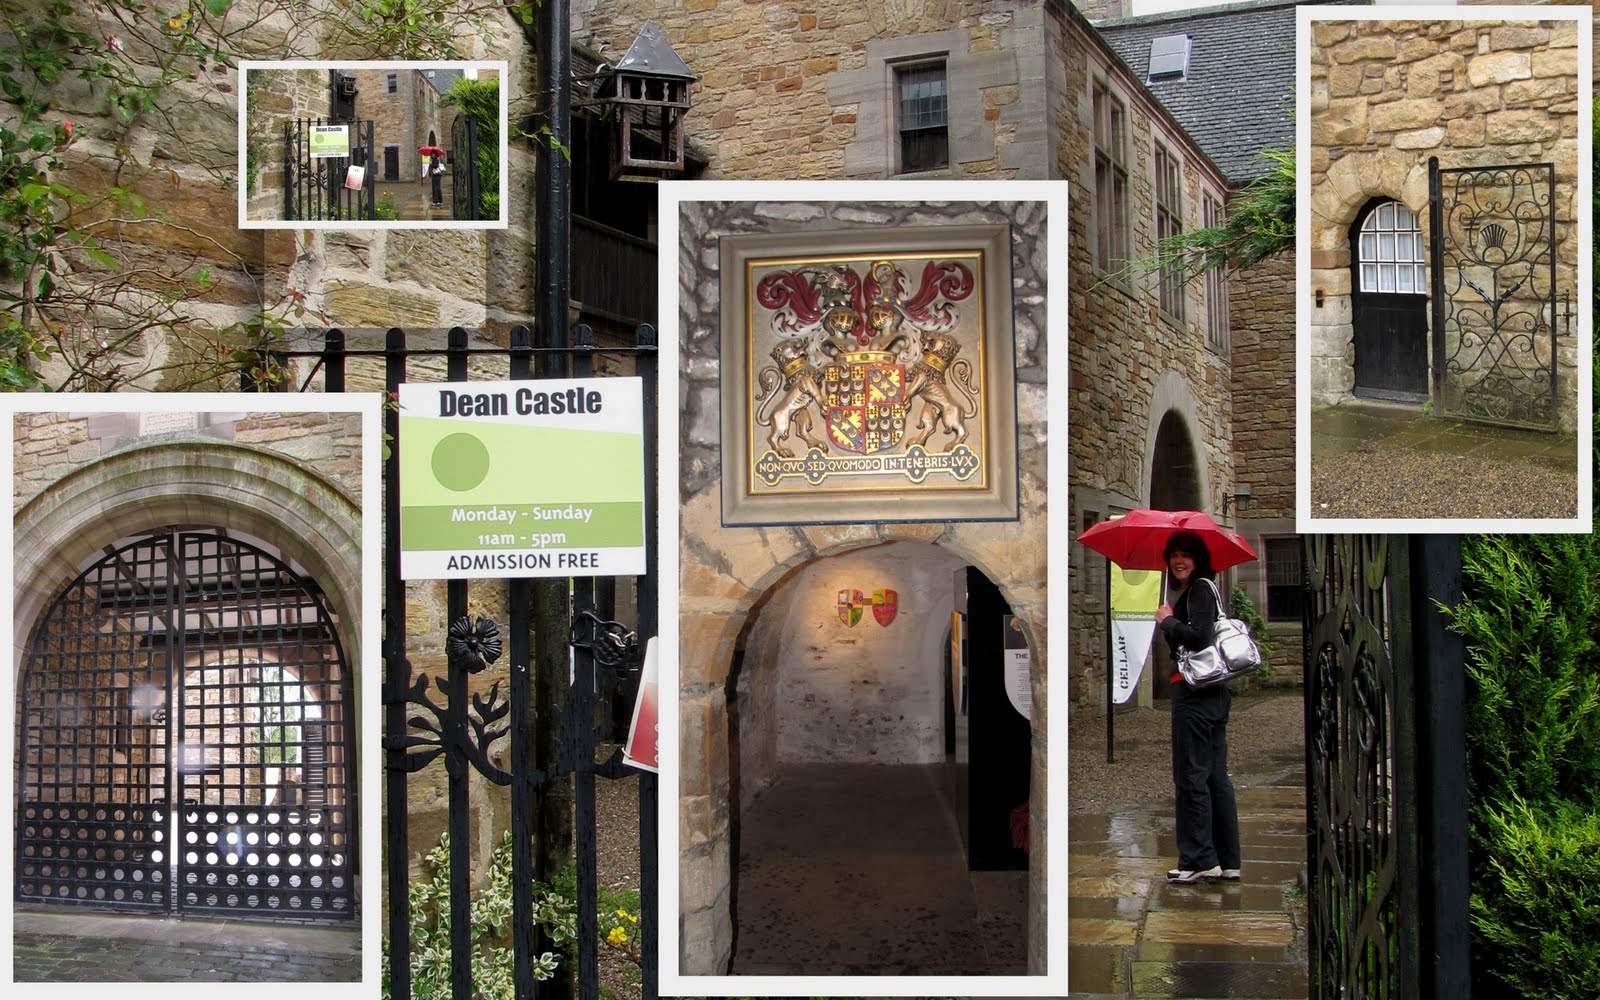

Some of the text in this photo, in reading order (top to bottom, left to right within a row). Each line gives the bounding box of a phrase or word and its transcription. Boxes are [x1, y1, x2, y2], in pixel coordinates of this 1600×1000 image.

[439, 387, 602, 417] Dean Castle
[759, 462, 780, 473] NON
[783, 462, 805, 473] QVO
[807, 461, 826, 471] SED
[828, 459, 881, 472] QVOMODO
[885, 459, 897, 469] IN
[951, 456, 974, 467] LVX
[451, 505, 517, 525] Monday
[533, 504, 593, 523] Sunday
[478, 532, 515, 545] 11am
[531, 531, 566, 548] 5pm
[446, 552, 599, 570] ADMISSION FREE
[1118, 635, 1129, 690] CELLAR
